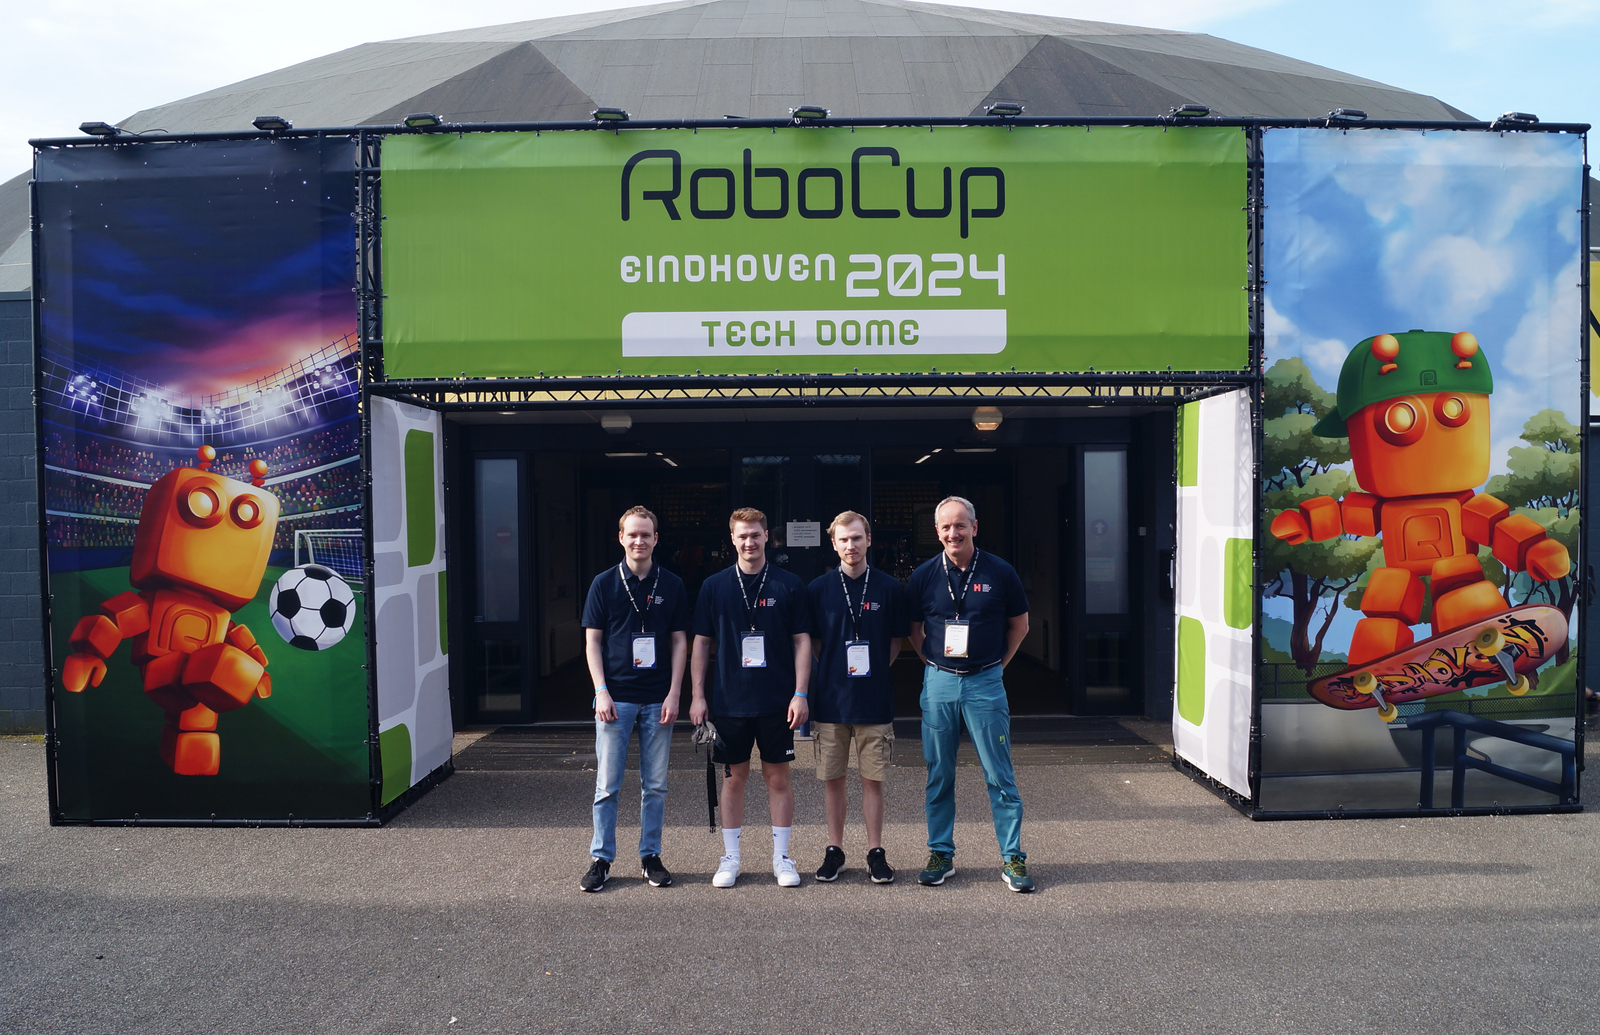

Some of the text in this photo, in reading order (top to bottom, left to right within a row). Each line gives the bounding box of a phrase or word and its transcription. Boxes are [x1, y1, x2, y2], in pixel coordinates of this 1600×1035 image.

[621, 147, 1005, 239] RoboCup
[620, 253, 1006, 298] EINDHOVEN 2024
[701, 319, 920, 347] TECH DOME
